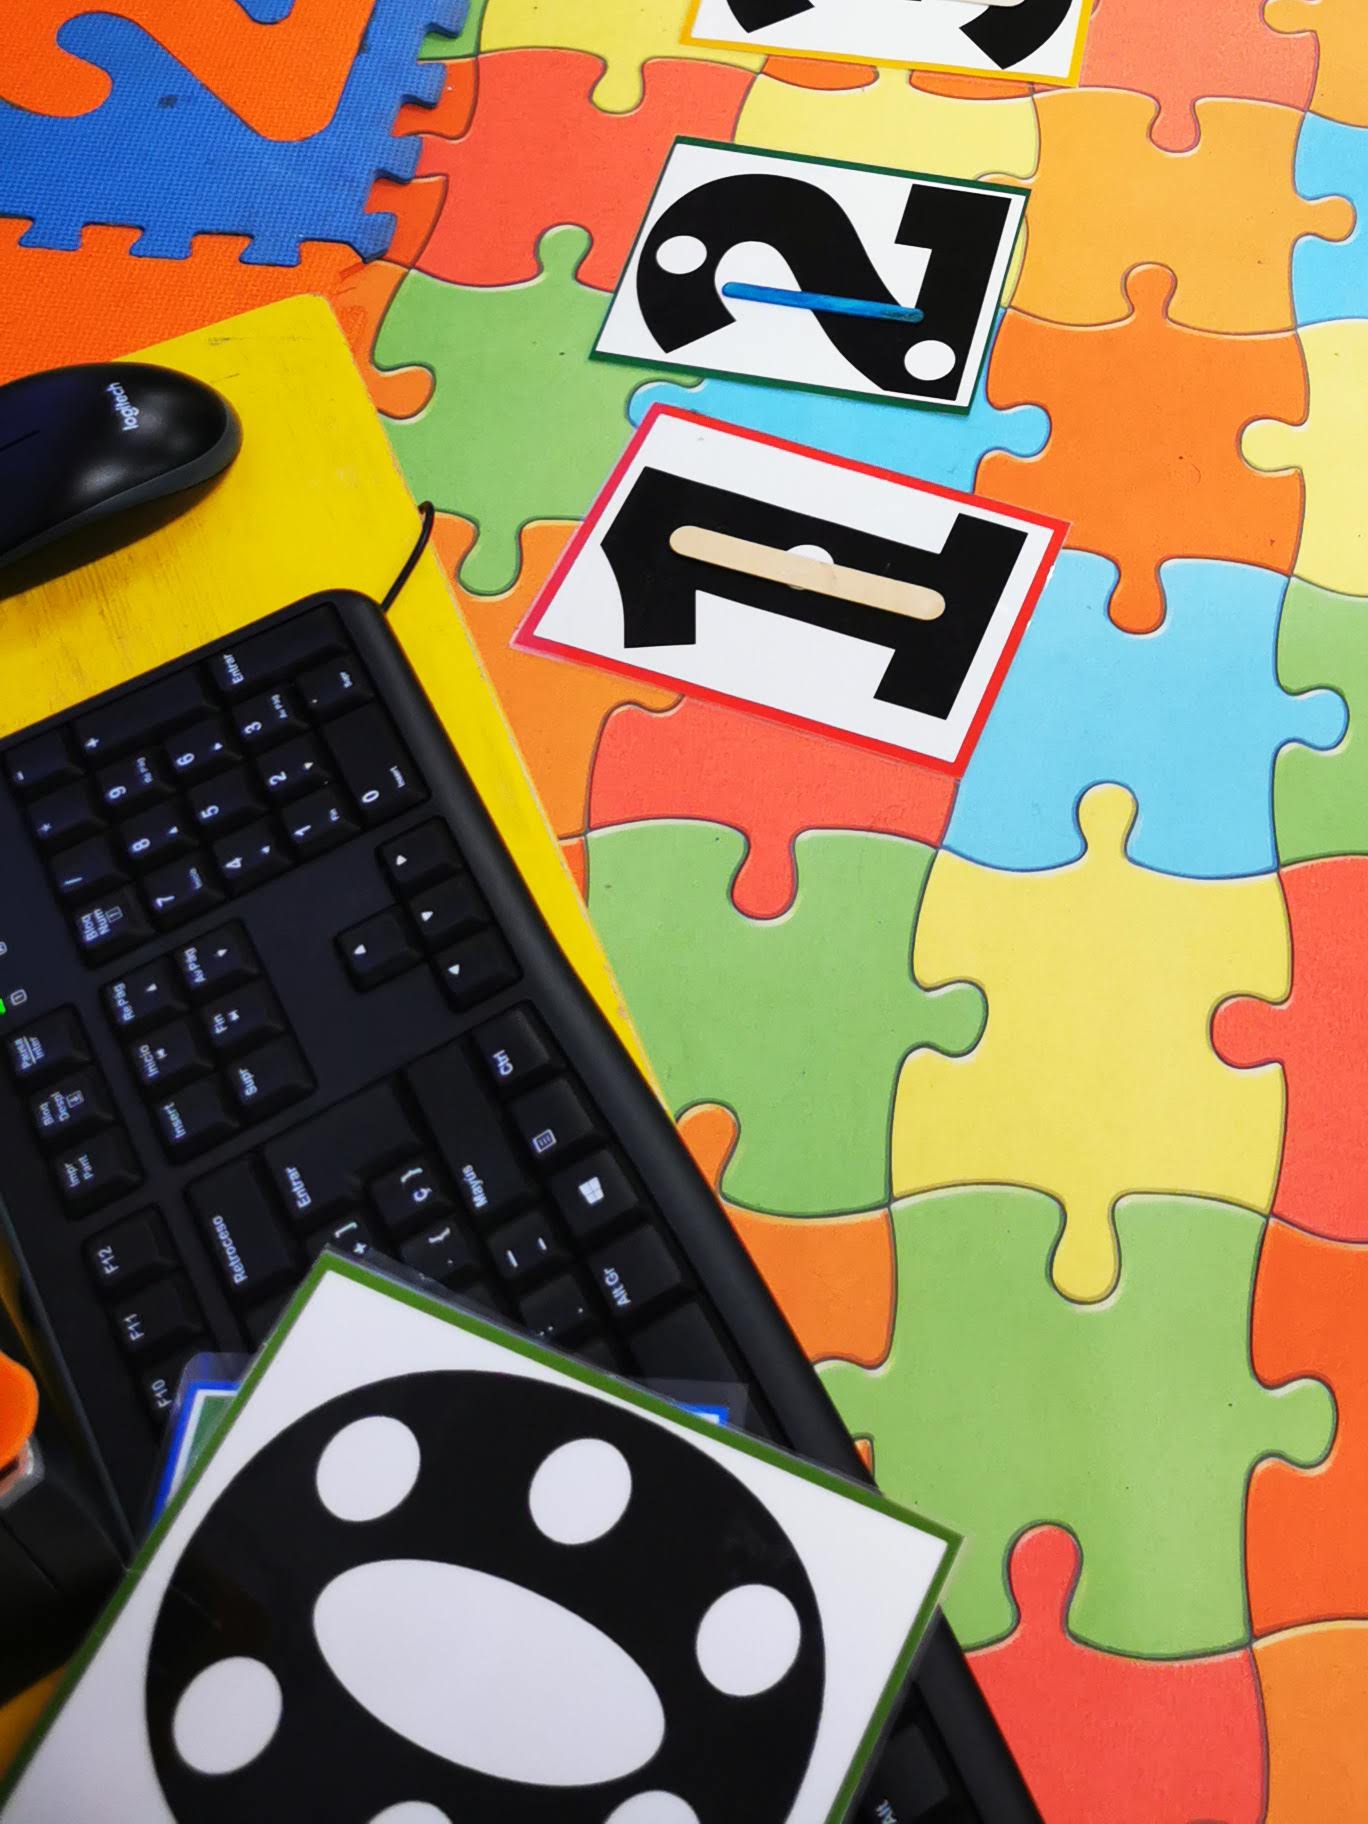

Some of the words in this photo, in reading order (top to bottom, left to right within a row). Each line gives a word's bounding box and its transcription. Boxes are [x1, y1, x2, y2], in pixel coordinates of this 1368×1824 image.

[636, 174, 1012, 401] 2
[105, 382, 140, 432] logitech
[600, 466, 1028, 720] 1
[223, 653, 244, 685] Entrar
[244, 721, 262, 734] 3
[176, 752, 195, 766] 6
[268, 771, 287, 786] 2
[108, 785, 127, 799] 9
[201, 804, 219, 819] 5
[294, 824, 312, 838] 1
[131, 838, 150, 853] 8
[224, 857, 243, 869] 4
[156, 895, 175, 908] 7
[81, 912, 99, 942] Bloq
[93, 908, 111, 935] Num
[121, 1004, 136, 1021] Re
[213, 1013, 228, 1034] Fin
[14, 1037, 32, 1070] Pausa
[139, 1044, 160, 1078] Inicio
[492, 1050, 513, 1076] Ctrl
[238, 1068, 258, 1096] Supr
[39, 1102, 54, 1127] Bloq
[163, 1101, 187, 1139] Insert
[285, 1166, 312, 1209] Entrar
[98, 1246, 119, 1274] F12
[212, 1215, 249, 1285] Retroceso
[603, 1266, 619, 1287] Gr
[610, 1285, 632, 1308] Alt
[124, 1313, 144, 1341] F11
[152, 1378, 173, 1408] F10
